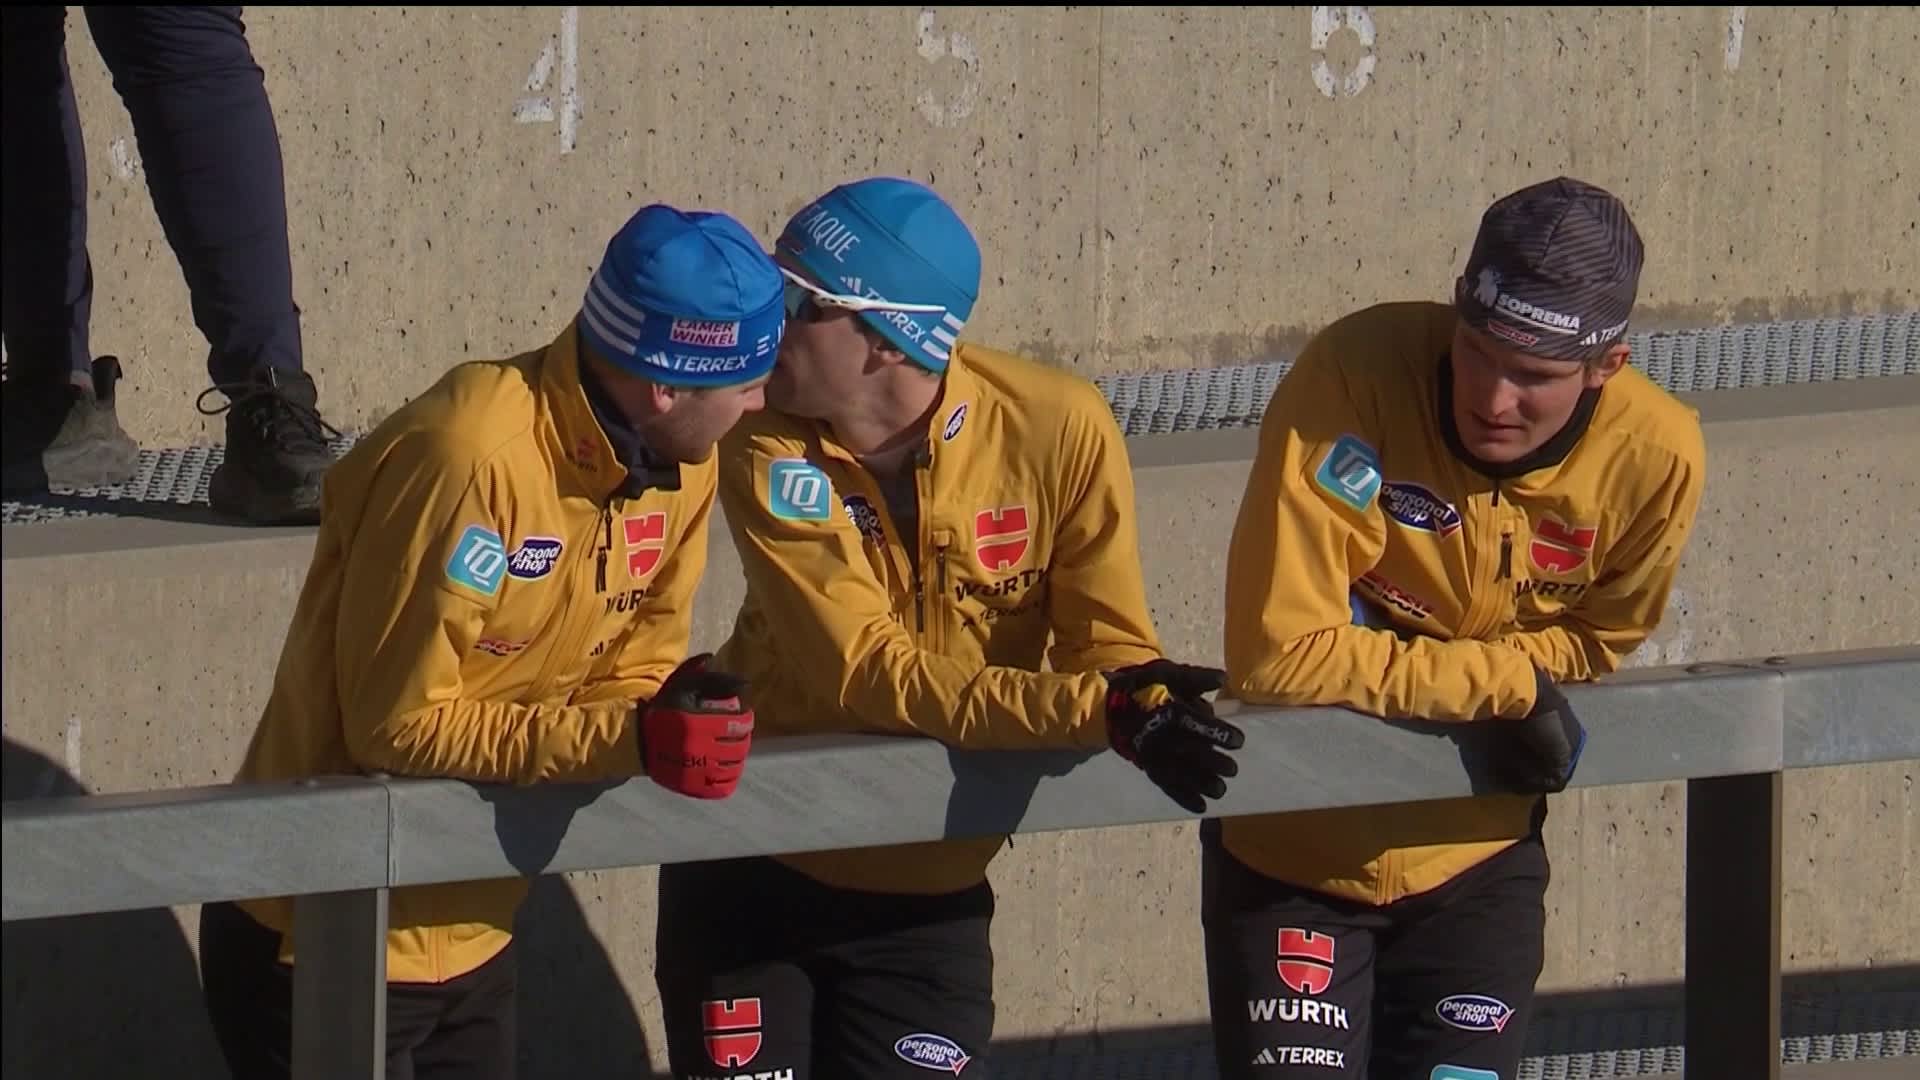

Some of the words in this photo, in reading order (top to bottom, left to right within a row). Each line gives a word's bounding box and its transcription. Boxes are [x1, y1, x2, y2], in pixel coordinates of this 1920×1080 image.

[512, 7, 580, 154] 4
[1498, 293, 1580, 329] SOPREMA
[673, 329, 736, 345] WINKEL
[673, 353, 751, 372] TERREX
[1388, 500, 1430, 523] shop
[1248, 998, 1350, 1030] WÜRTH
[1442, 1000, 1502, 1016] personal
[1454, 1009, 1487, 1025] shop
[901, 1039, 959, 1059] personal
[912, 1047, 946, 1064] shop
[1277, 1046, 1345, 1069] TERREX
